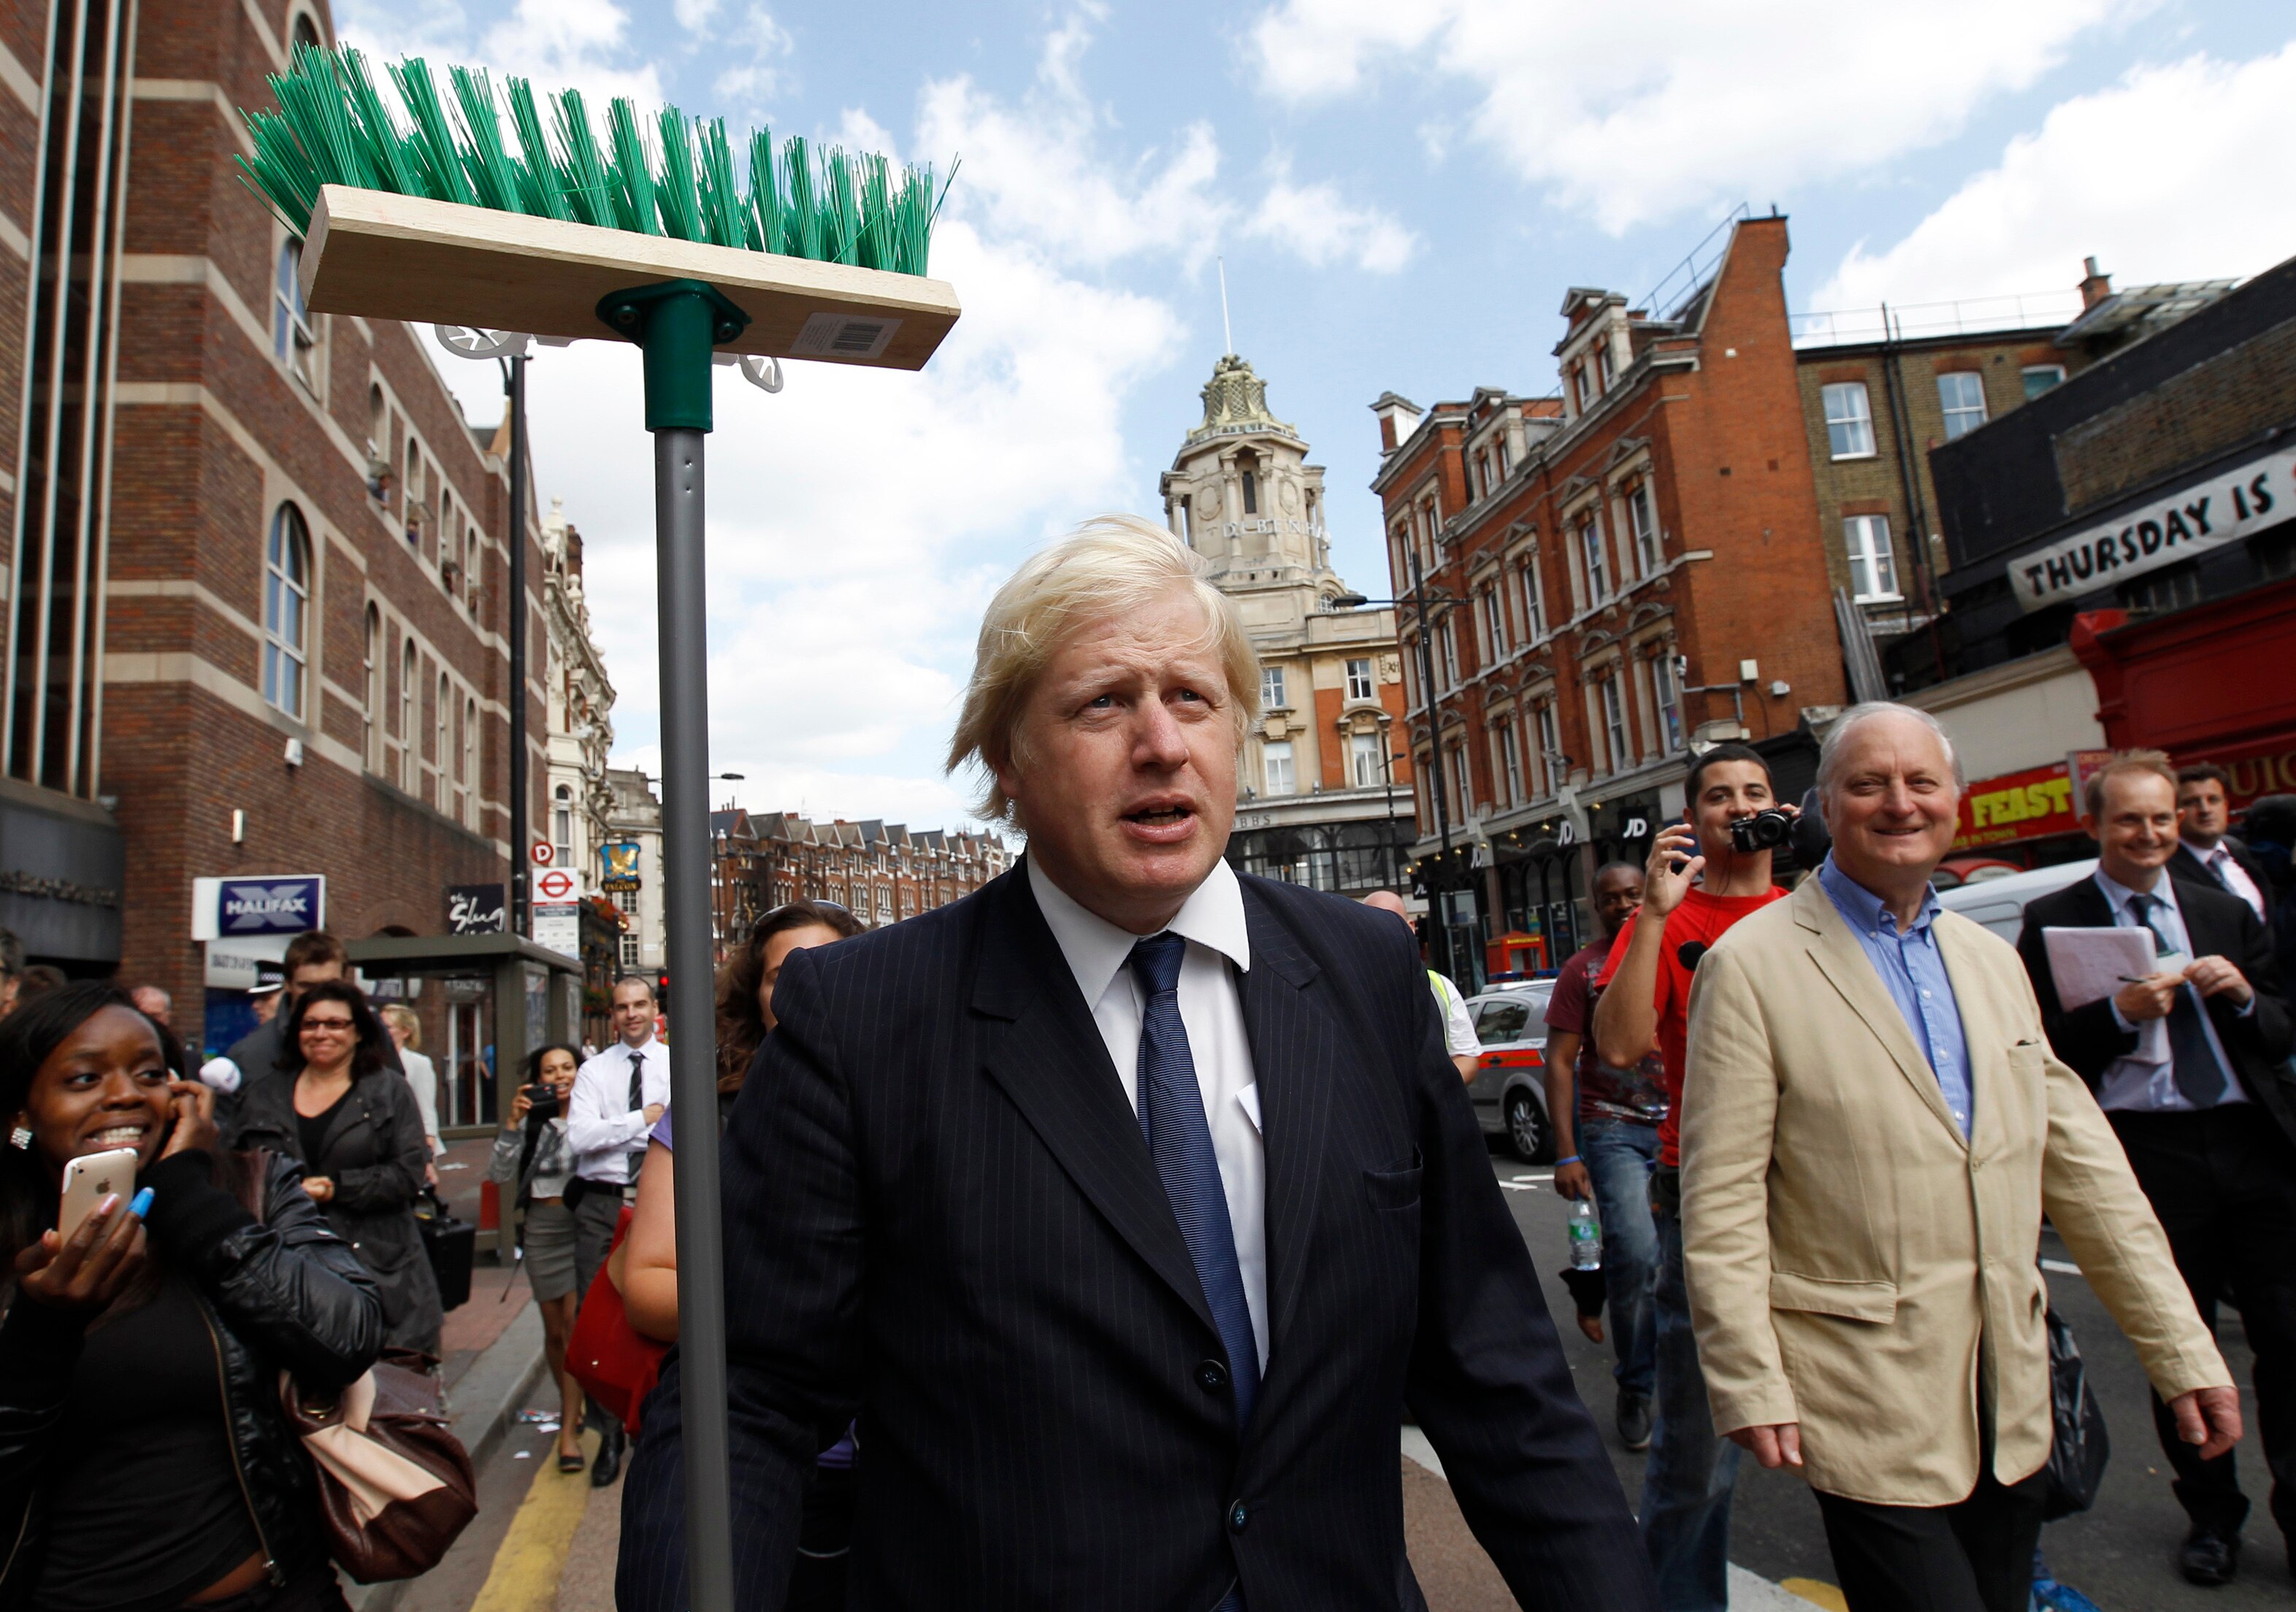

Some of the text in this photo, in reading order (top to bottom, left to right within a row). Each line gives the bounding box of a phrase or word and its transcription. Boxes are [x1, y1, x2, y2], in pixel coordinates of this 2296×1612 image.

[2025, 496, 2212, 596] THURSDAY
[2232, 472, 2275, 521] IS
[1970, 777, 2072, 828] FEAST
[1558, 820, 1573, 847] JD
[1623, 818, 1648, 838] JD
[535, 845, 551, 861] D
[1470, 847, 1483, 870] JD
[226, 897, 307, 916] HALIFAX
[449, 896, 505, 932] Slug
